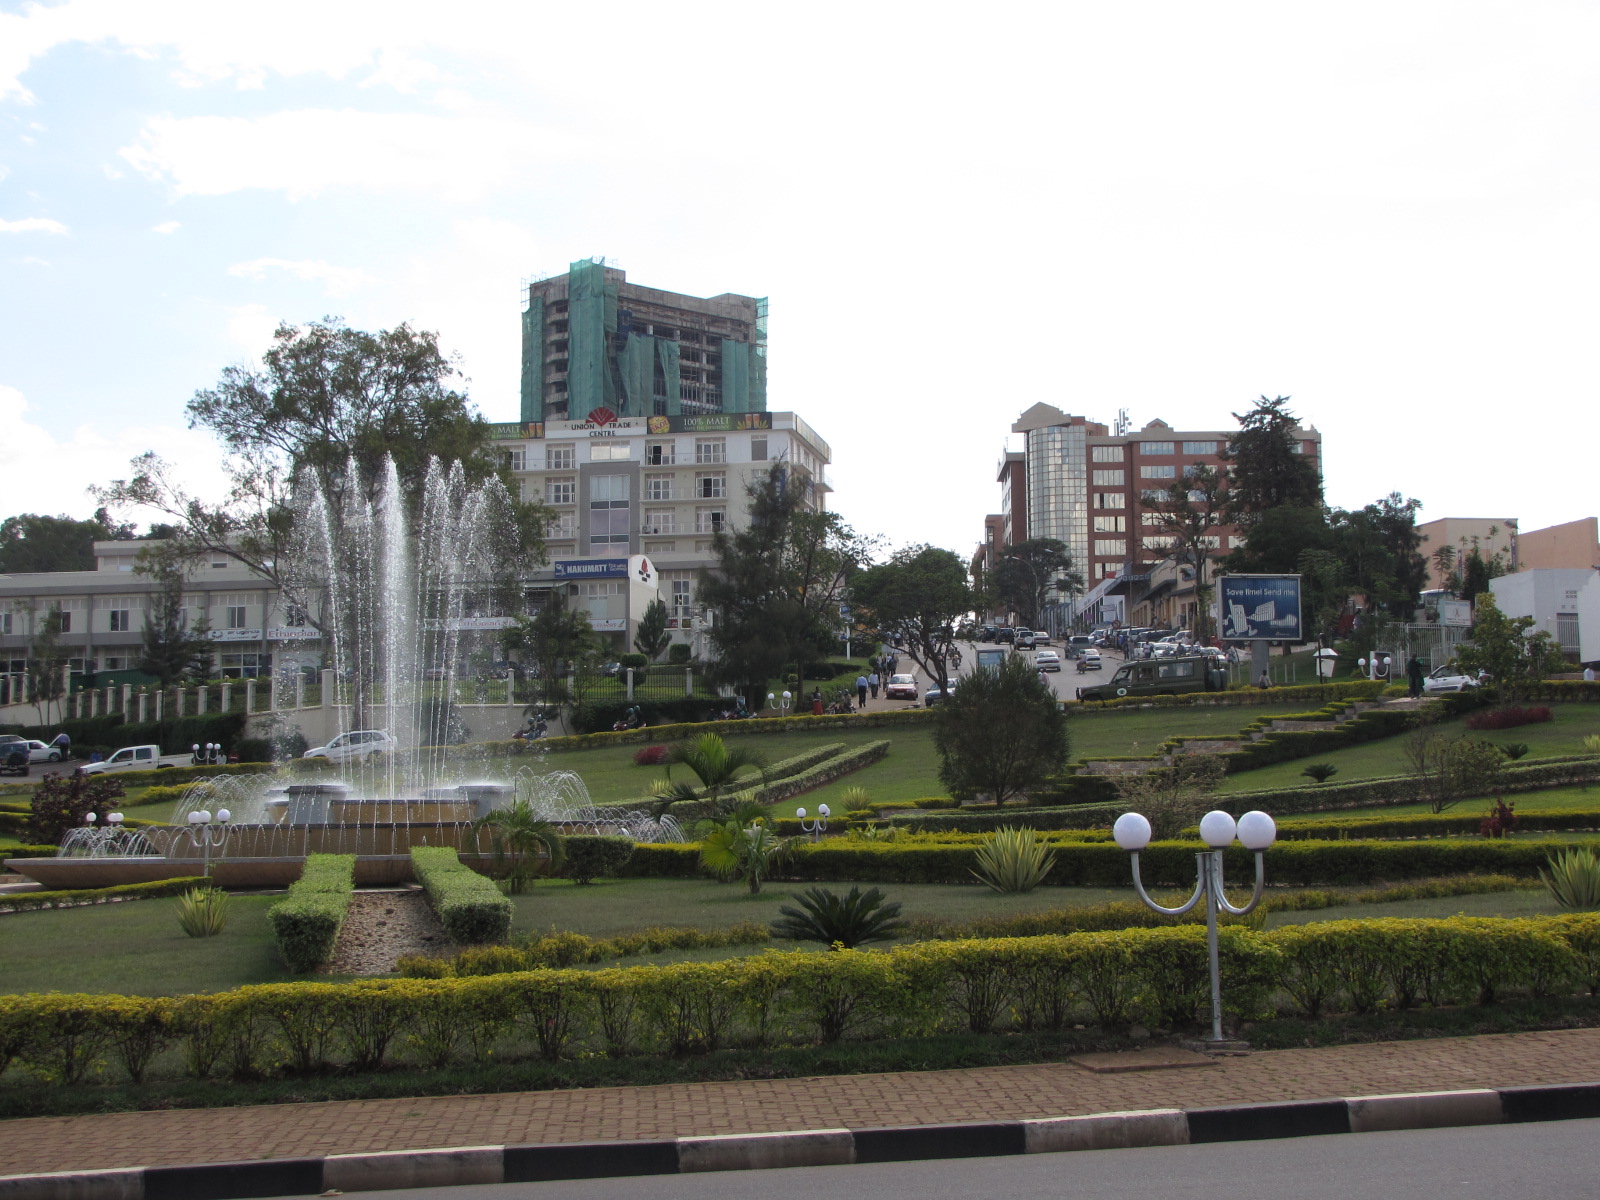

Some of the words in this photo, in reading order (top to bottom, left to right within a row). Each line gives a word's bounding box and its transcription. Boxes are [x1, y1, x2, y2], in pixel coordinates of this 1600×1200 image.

[706, 416, 731, 425] MALT
[609, 421, 632, 429] TRADE
[497, 425, 521, 434] MALT
[1226, 588, 1244, 596] Save
[1264, 588, 1282, 596] Send
